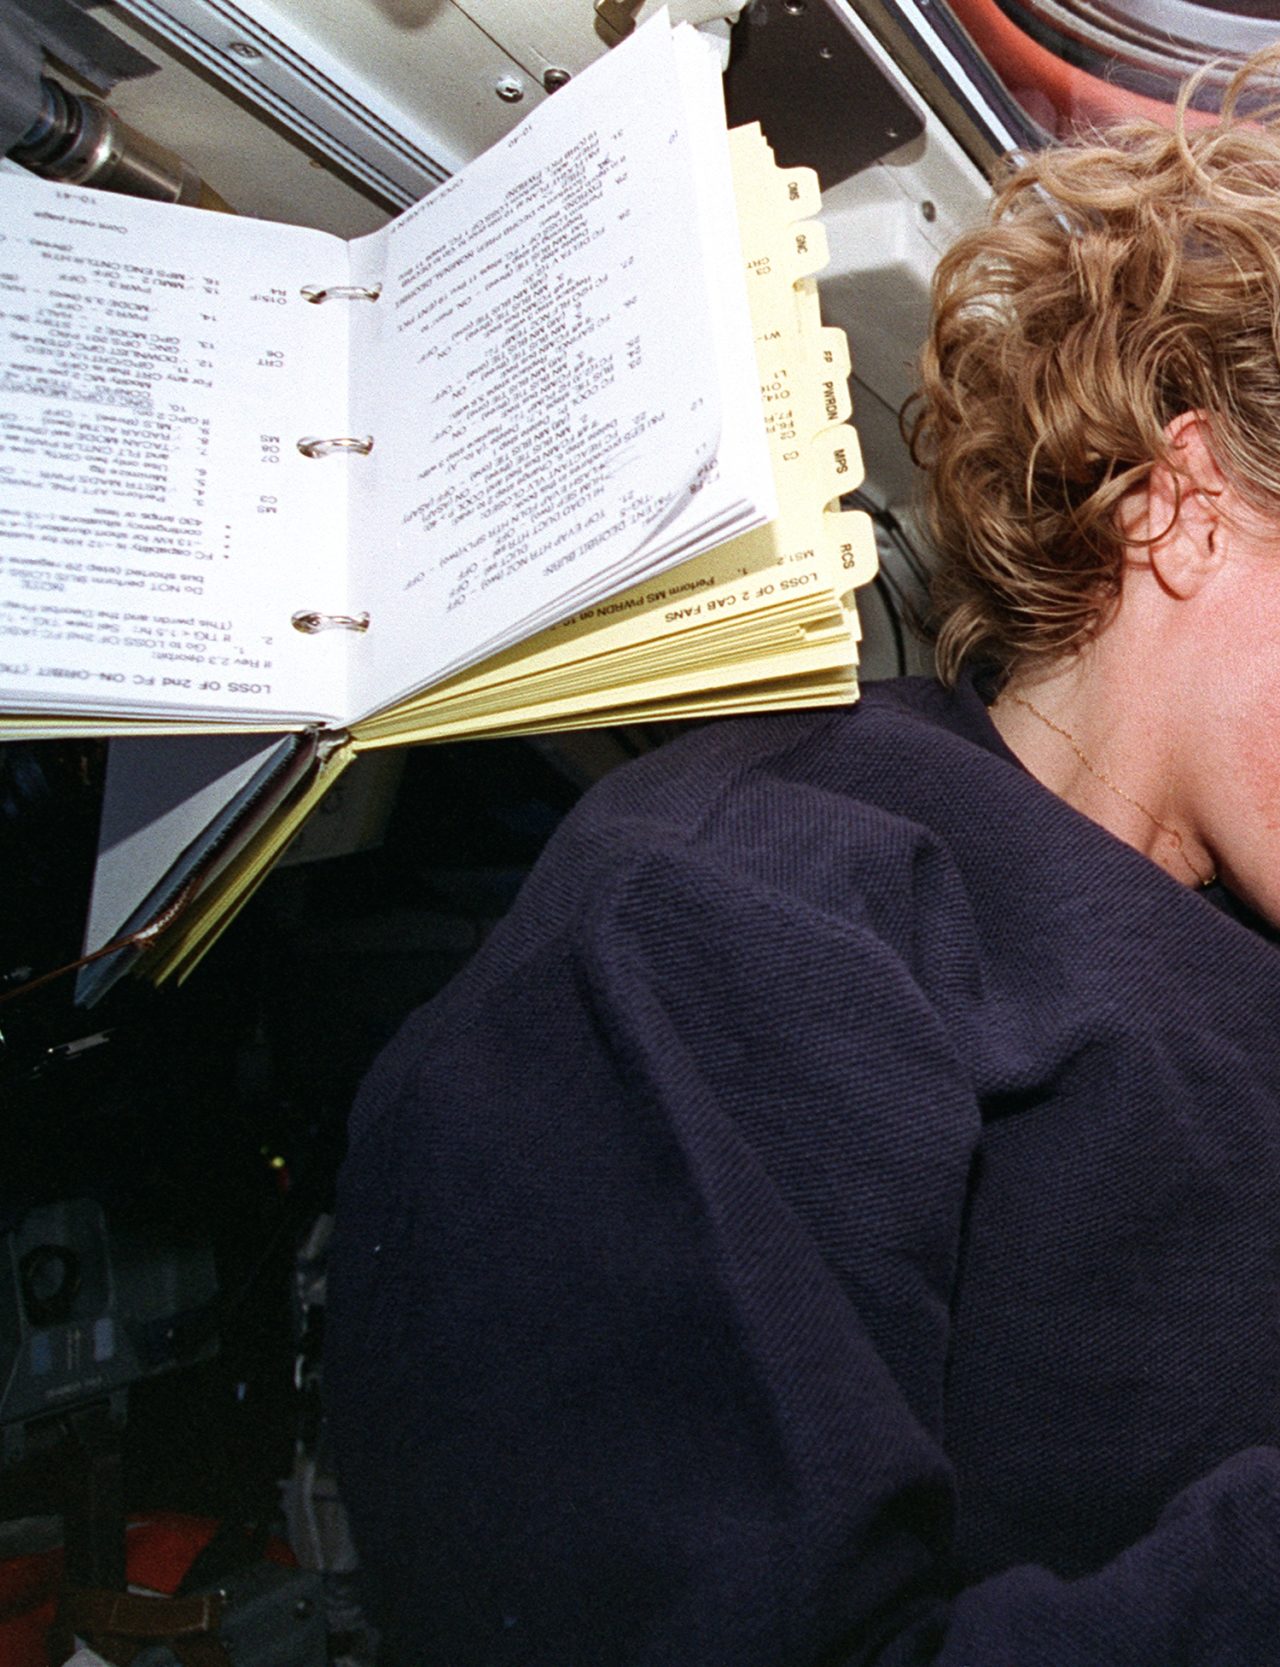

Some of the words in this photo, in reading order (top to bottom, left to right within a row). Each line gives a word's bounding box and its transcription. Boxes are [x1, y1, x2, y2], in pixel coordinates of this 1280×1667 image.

[796, 234, 808, 254] GNC
[258, 359, 283, 367] CRT
[822, 381, 838, 420] PWRDN
[550, 442, 601, 478] REACTANT
[834, 449, 848, 474] MPS
[528, 477, 545, 489] VLV
[541, 485, 567, 506] EVAP
[557, 490, 577, 507] SEP
[481, 489, 524, 518] CLOSED:
[563, 494, 591, 516] LOAD
[511, 503, 537, 523] FDLN
[585, 510, 605, 527] TOP
[179, 518, 202, 526] 430
[533, 512, 560, 534] DUCT
[488, 521, 509, 538] HTR
[554, 523, 581, 546] EVAP
[508, 531, 529, 549] HTR
[133, 544, 190, 555] capability
[196, 551, 213, 560] FC
[530, 542, 551, 560] HTR
[840, 544, 855, 570] RCS
[125, 569, 176, 580] shorted
[459, 563, 478, 580] OFF
[92, 578, 145, 587] perform
[180, 574, 204, 583] bus
[780, 572, 818, 590] LOSS
[22, 580, 64, 592] NOTE
[151, 584, 180, 592] NOT
[184, 586, 203, 595] Do
[668, 576, 715, 596] Perform
[755, 584, 775, 598] OF
[646, 591, 666, 603] MS
[706, 594, 736, 611] CAB
[742, 590, 750, 602] 2
[596, 597, 644, 617] PWRDN
[664, 604, 702, 620] FANS
[154, 617, 194, 625] pwrdn
[199, 620, 232, 630] (This
[99, 636, 120, 645] OF
[124, 637, 164, 648] LOSS
[186, 643, 206, 652] Go
[157, 653, 204, 663] deorbit:
[235, 659, 259, 668] Rev
[38, 668, 125, 682] ON-ORBIT
[134, 675, 155, 686] FC
[162, 678, 191, 688] 2nd
[200, 681, 221, 691] OF
[228, 682, 270, 693] LOSS
